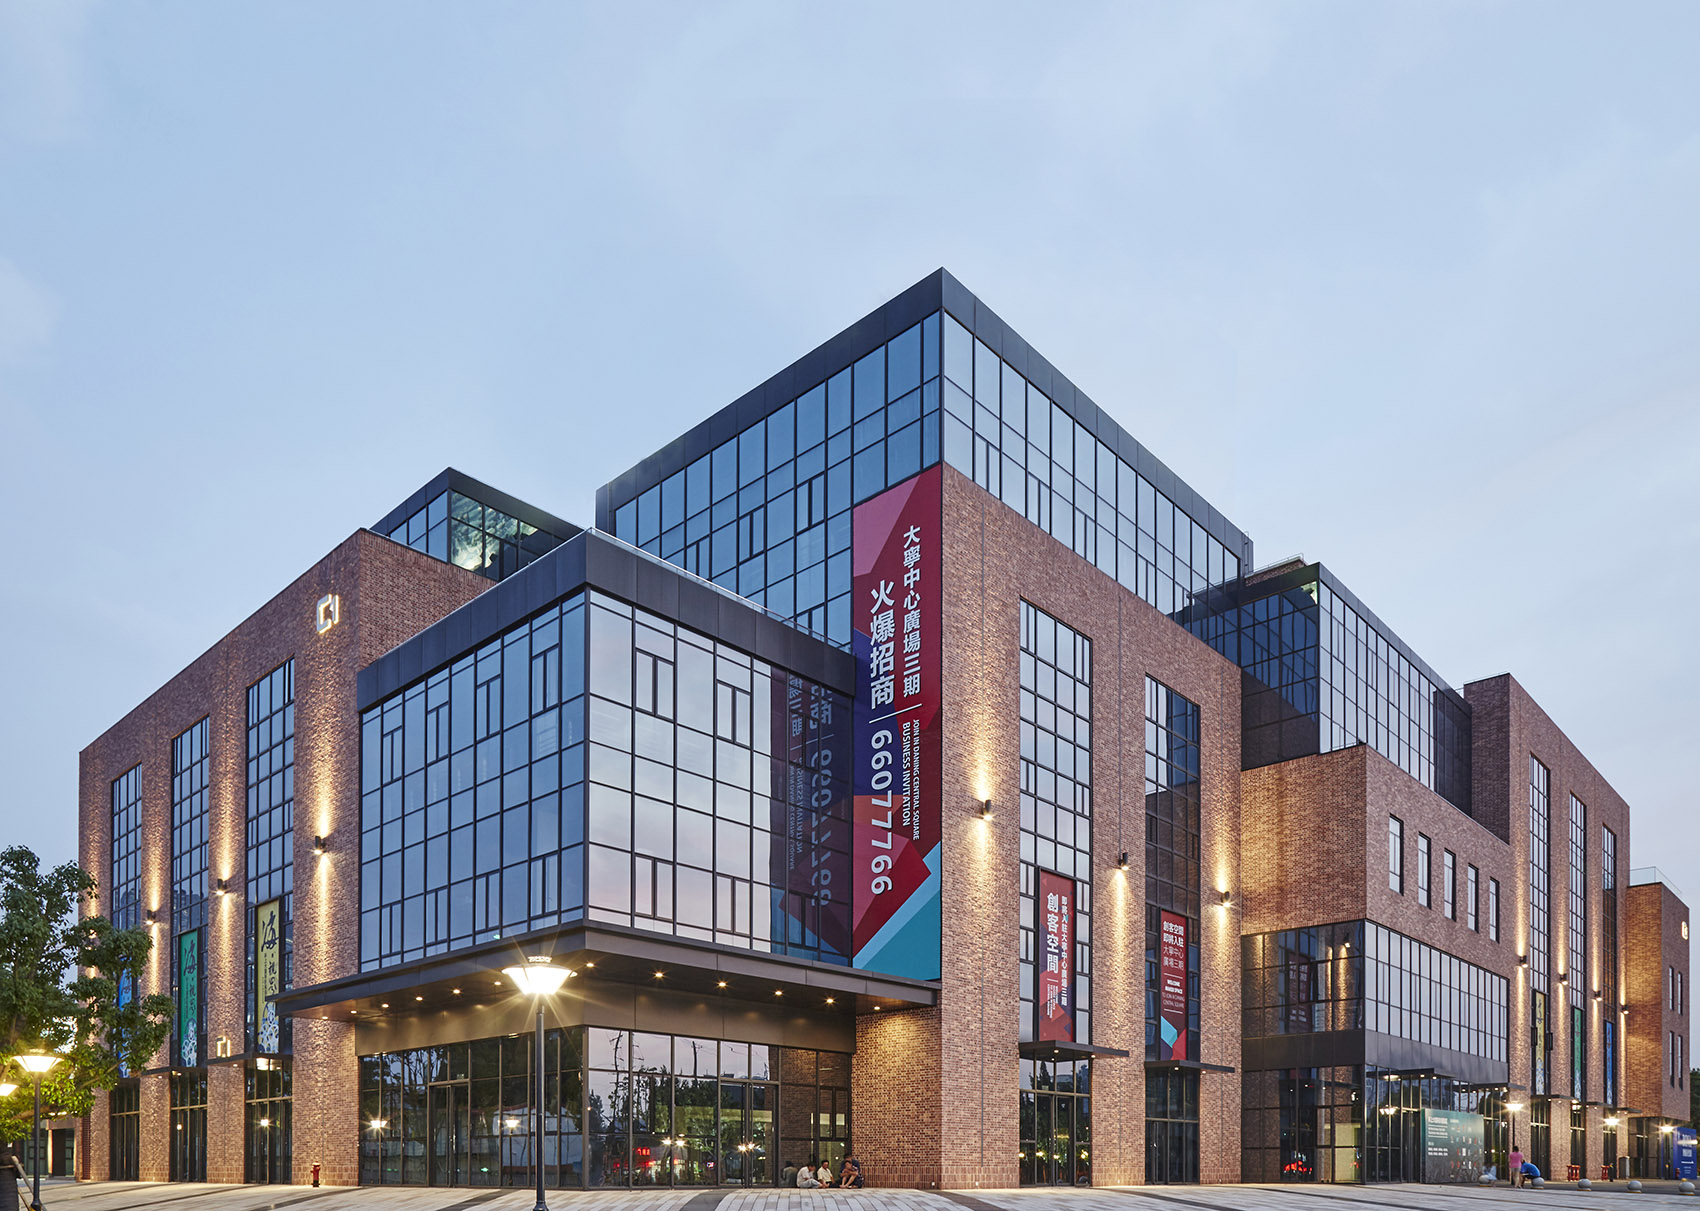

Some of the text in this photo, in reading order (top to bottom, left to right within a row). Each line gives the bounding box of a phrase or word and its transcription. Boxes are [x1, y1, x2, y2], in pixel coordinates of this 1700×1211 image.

[870, 579, 895, 710] 火爆招商
[903, 525, 921, 697] 大寧中心廣場三期
[903, 721, 911, 826] BUSINESS INVITATION
[913, 737, 920, 745] IN
[871, 729, 893, 895] 66077766
[1047, 892, 1059, 974] 創客空間
